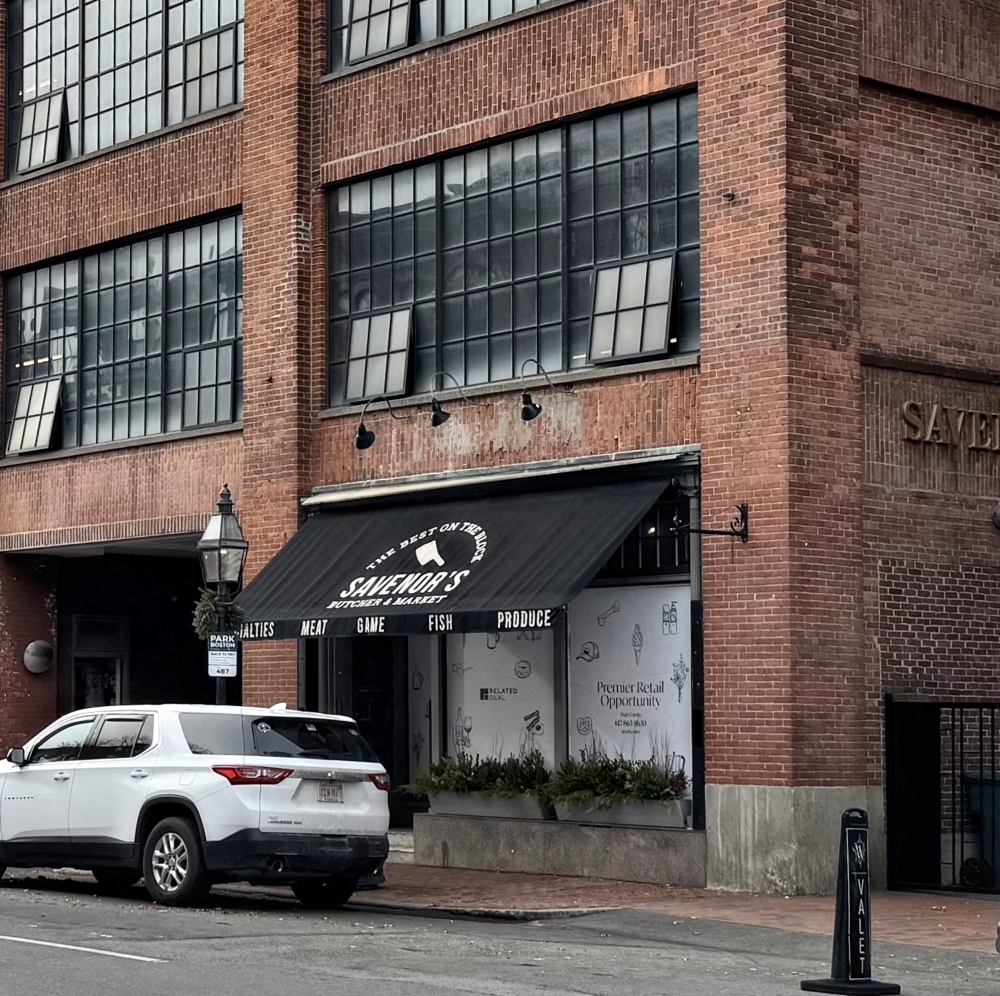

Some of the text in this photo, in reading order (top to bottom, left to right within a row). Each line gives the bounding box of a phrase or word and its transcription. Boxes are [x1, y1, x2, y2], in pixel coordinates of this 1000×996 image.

[365, 521, 488, 570] THE BEST ON THE BLOCK
[339, 569, 471, 598] SAVENOR'S
[326, 595, 448, 609] BUTCHER & MARKET
[300, 619, 328, 636] MEAT
[357, 616, 386, 634] GAME
[428, 614, 453, 631] FISH
[497, 609, 551, 629] PRODUCE
[597, 680, 664, 693] Premier Retail
[600, 694, 662, 710] Opportunity
[857, 878, 865, 974] VALET
